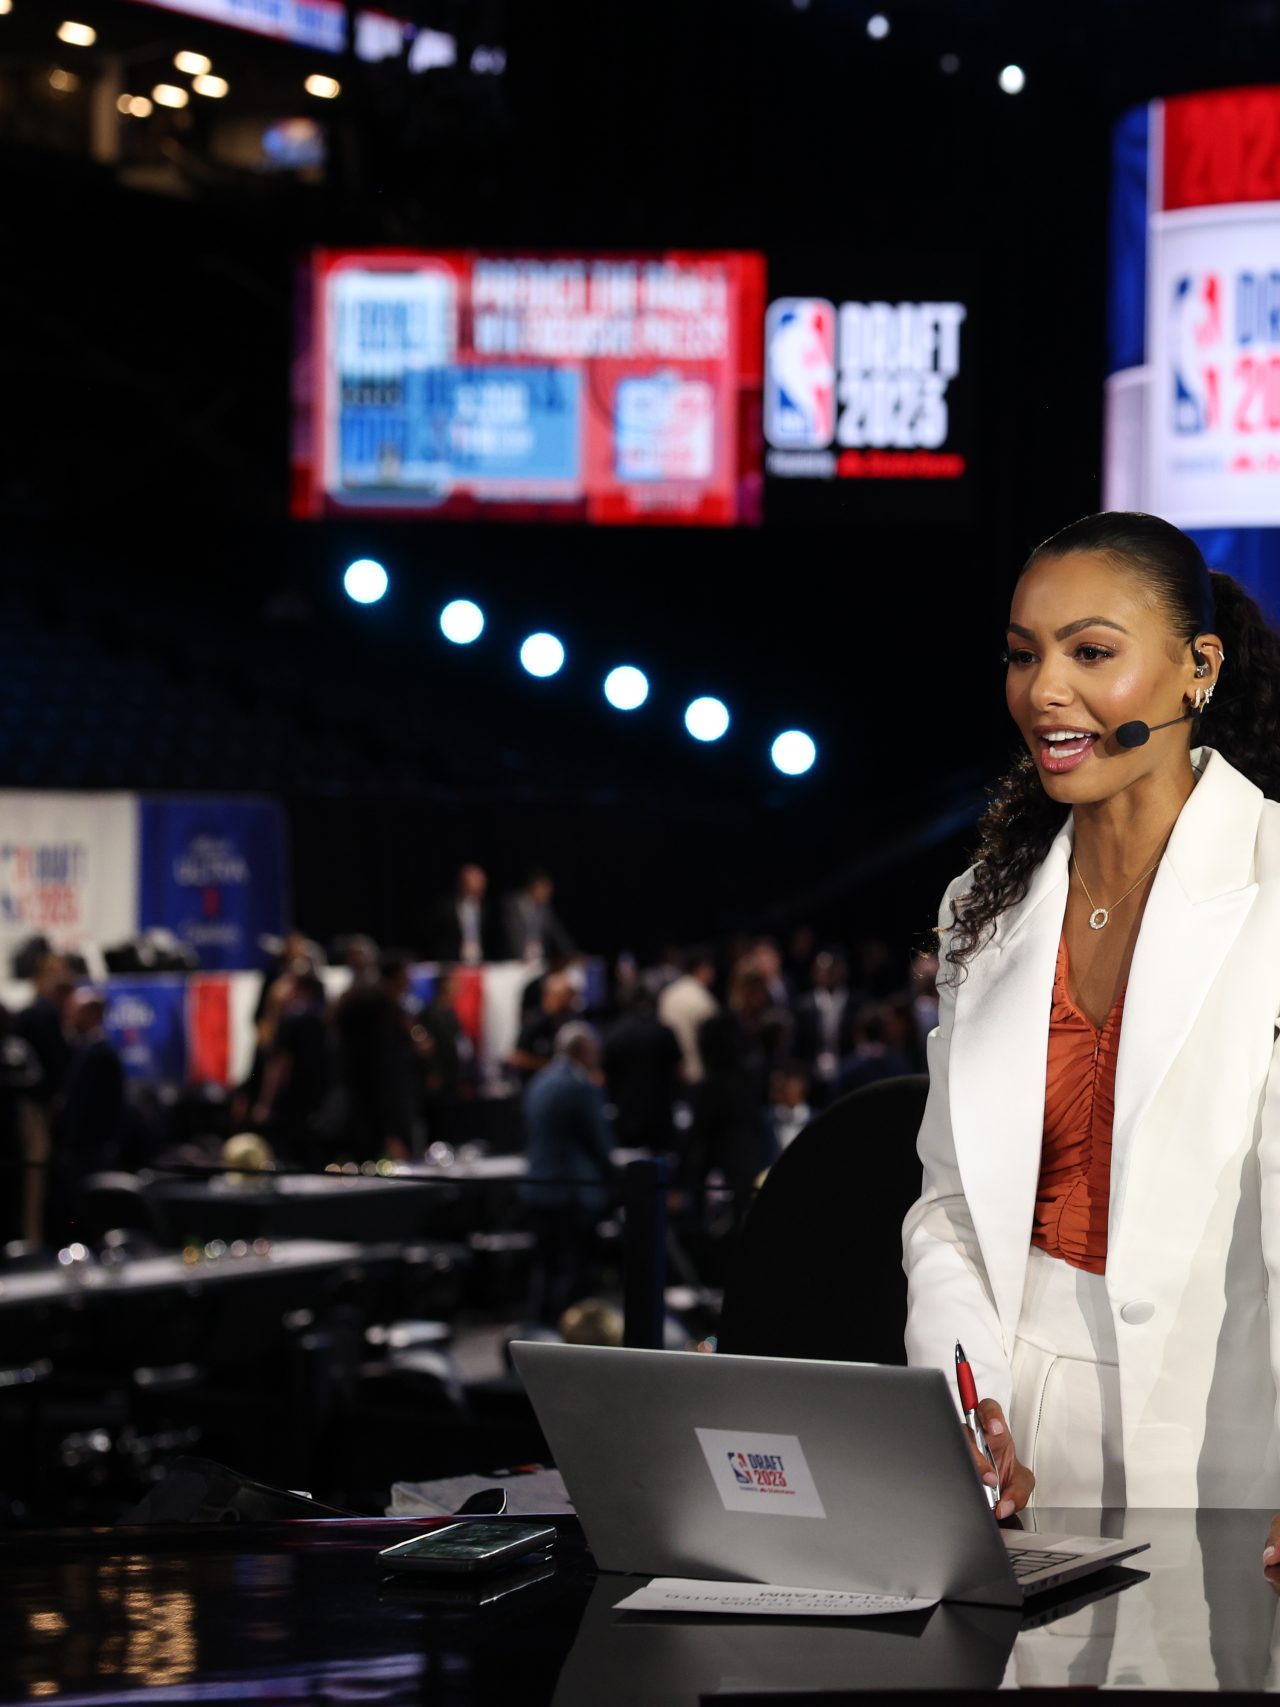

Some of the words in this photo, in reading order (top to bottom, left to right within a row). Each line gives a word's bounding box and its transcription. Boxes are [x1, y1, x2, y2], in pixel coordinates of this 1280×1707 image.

[841, 302, 966, 378] DRAFT
[839, 378, 947, 447] 2023
[748, 1454, 784, 1470] DRAFT
[754, 1470, 787, 1487] 2023
[664, 1593, 778, 1603] PRESENTED
